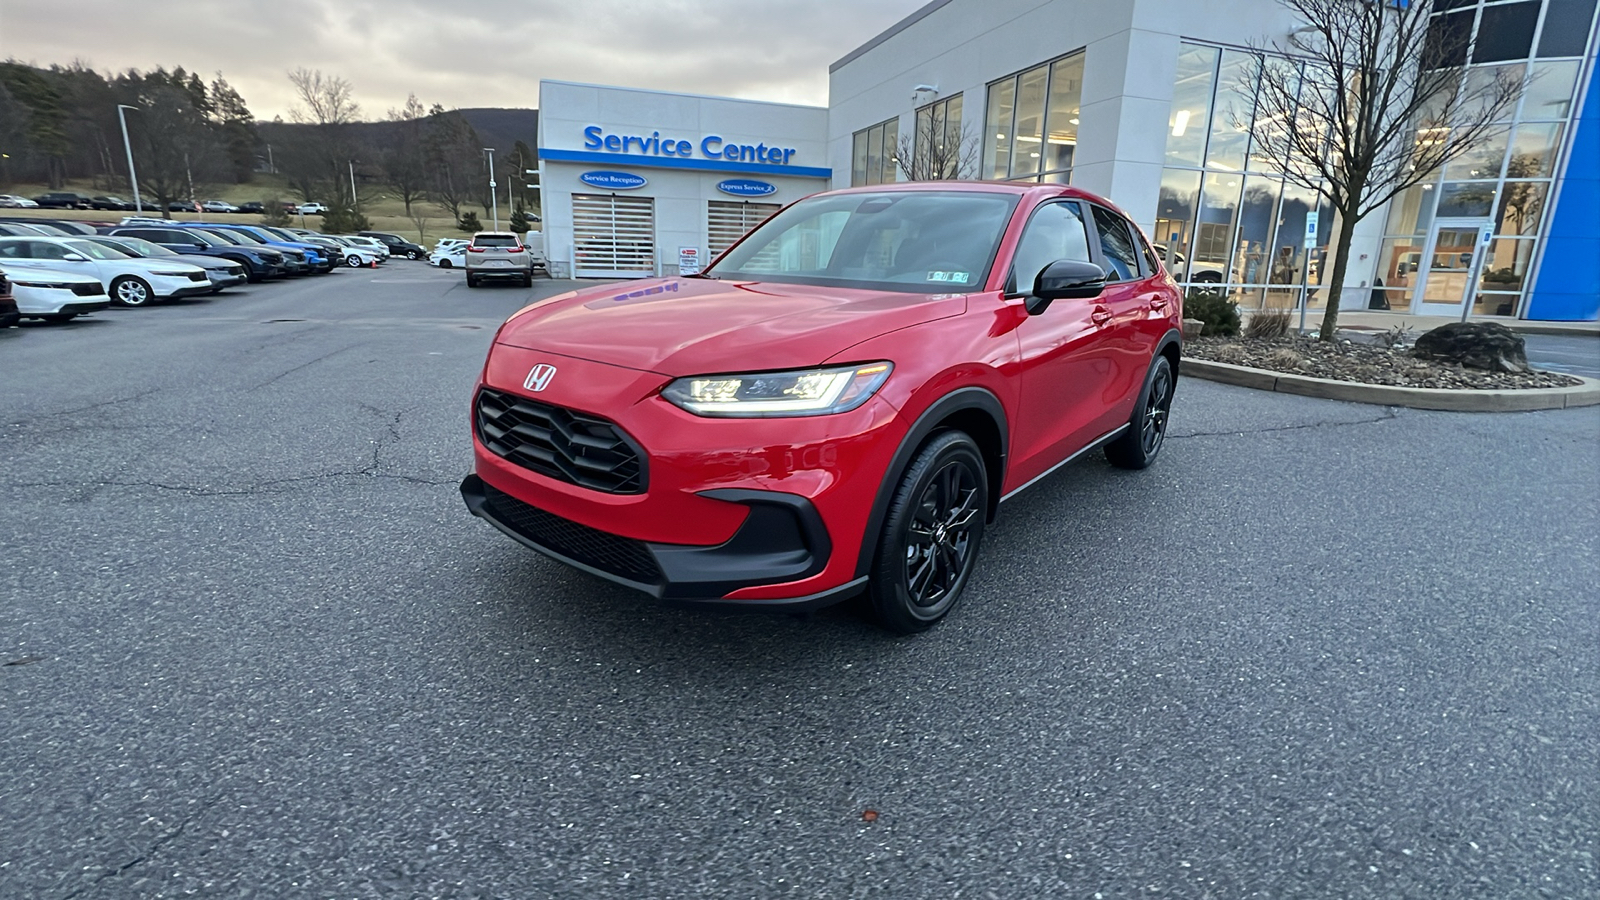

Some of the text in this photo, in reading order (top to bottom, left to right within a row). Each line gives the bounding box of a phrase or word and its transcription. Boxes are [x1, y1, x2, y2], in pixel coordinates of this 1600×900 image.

[584, 126, 796, 164] Service Center
[584, 174, 643, 184] Service Reception
